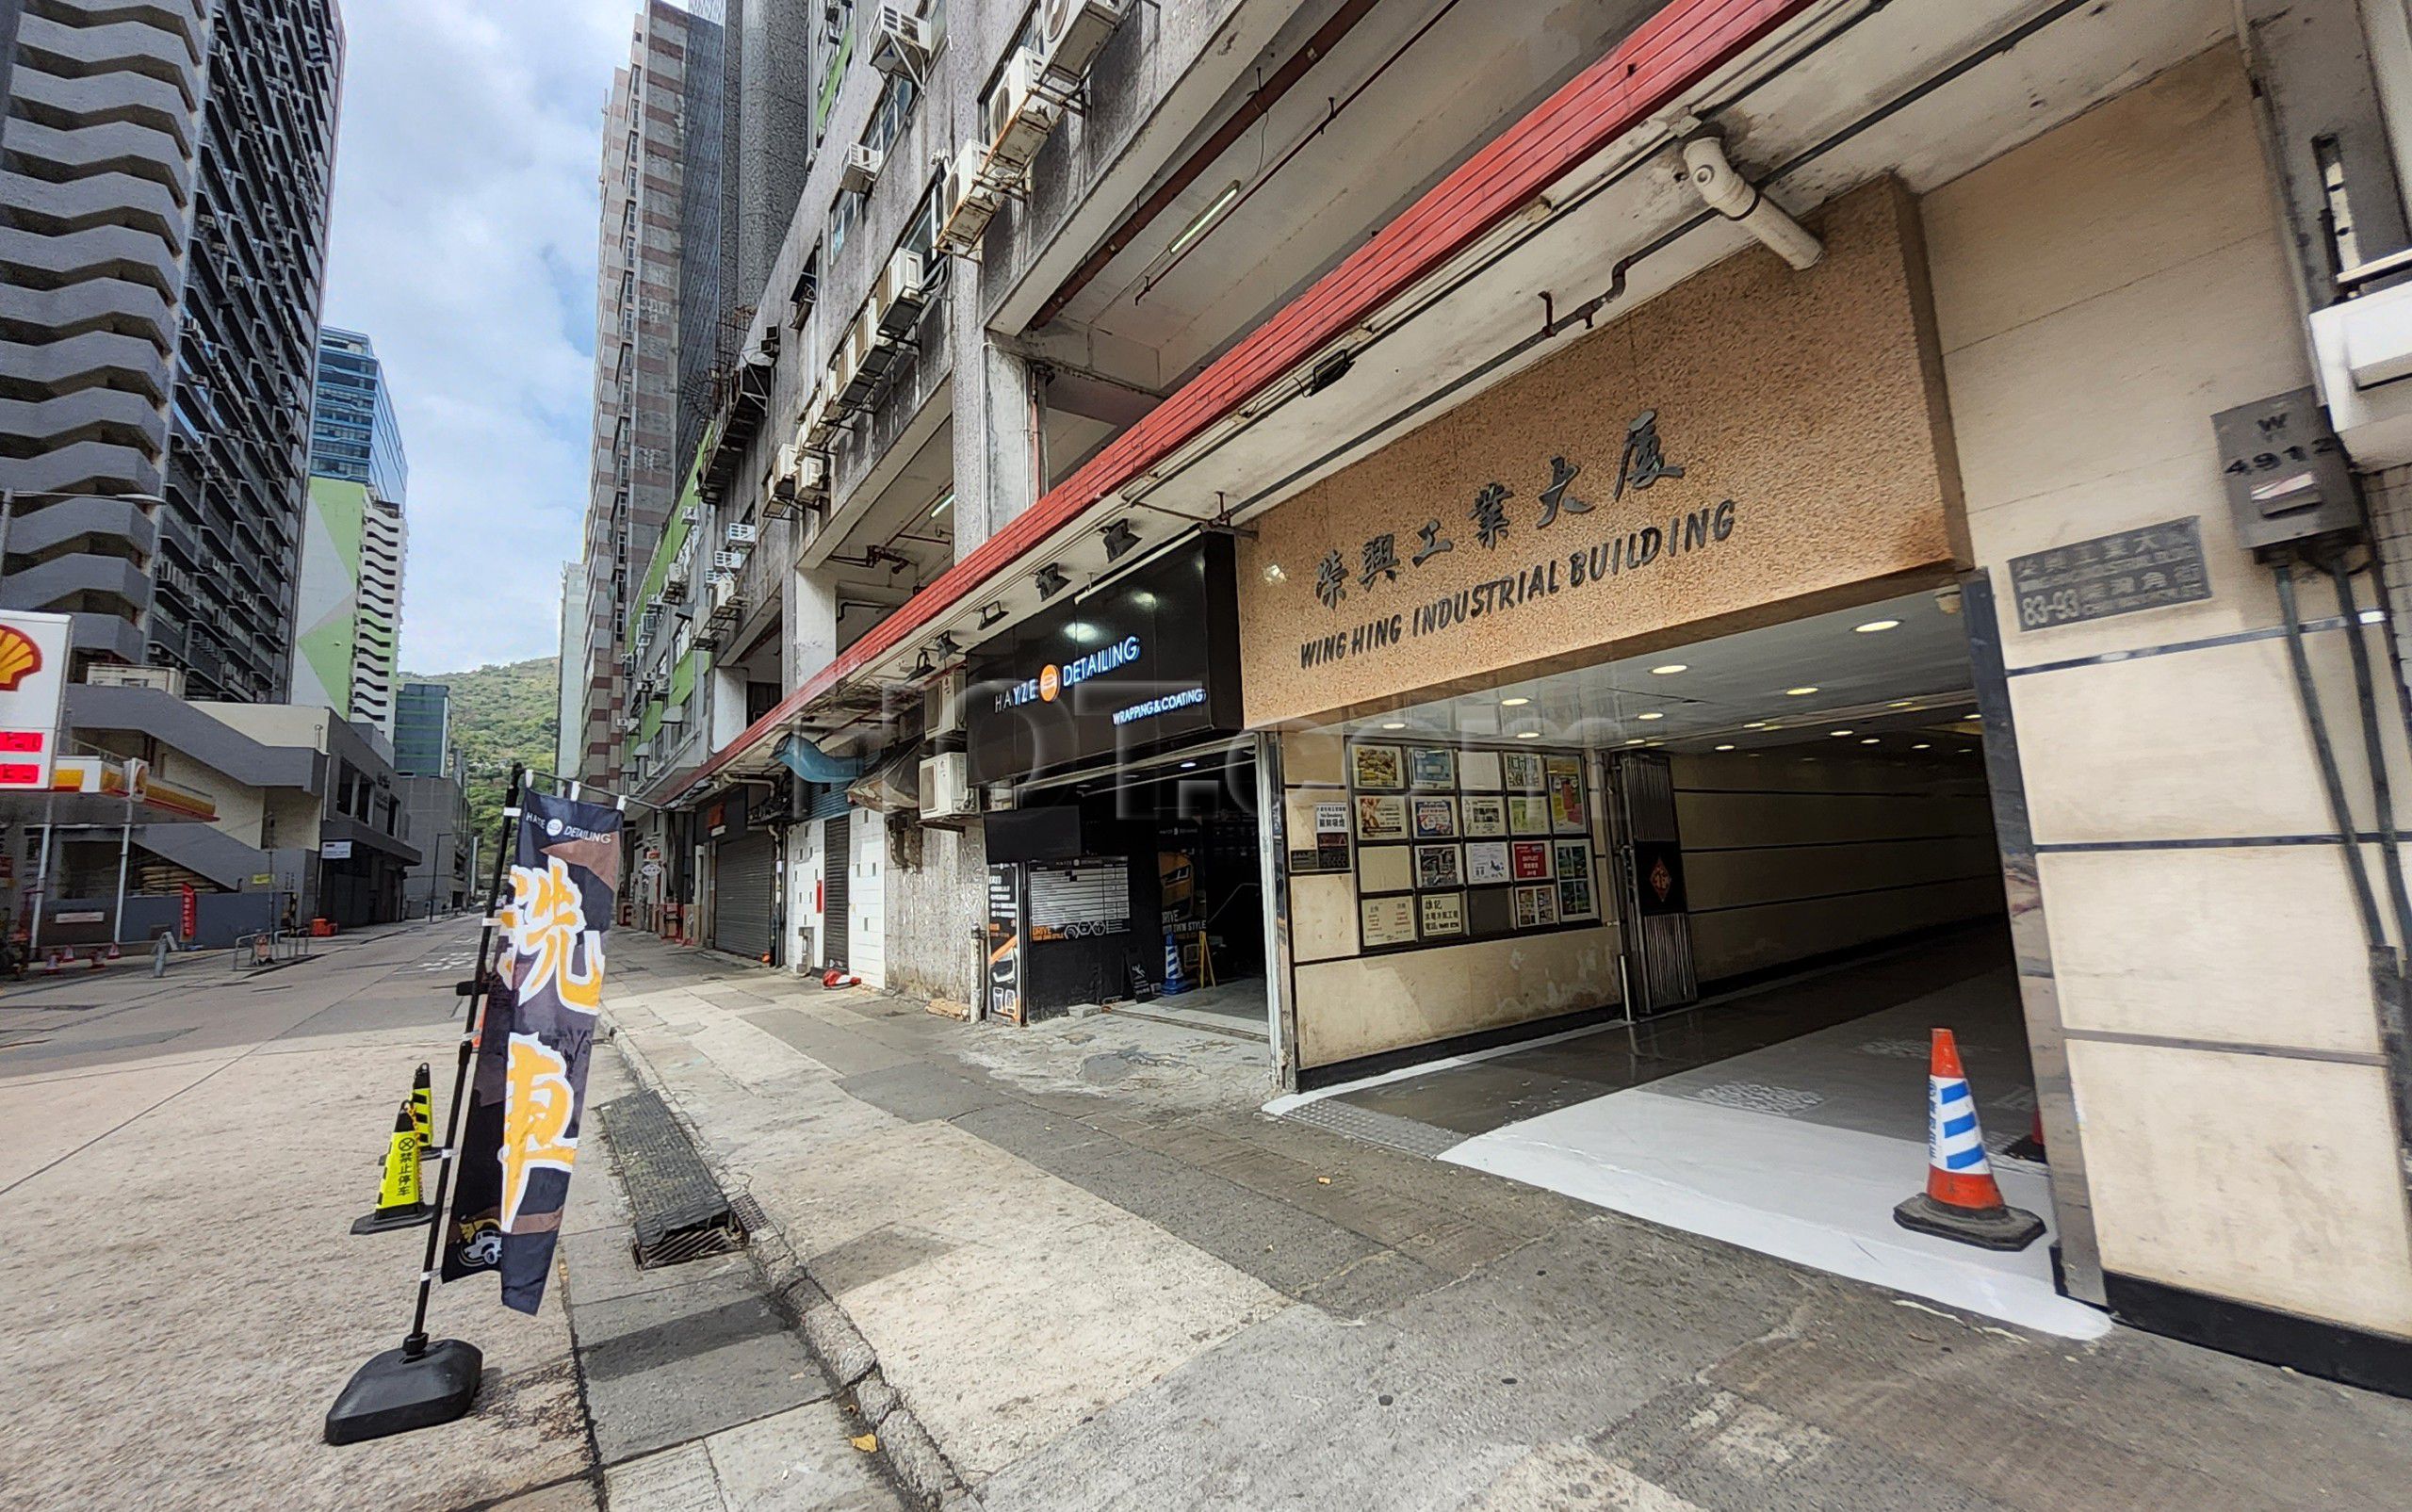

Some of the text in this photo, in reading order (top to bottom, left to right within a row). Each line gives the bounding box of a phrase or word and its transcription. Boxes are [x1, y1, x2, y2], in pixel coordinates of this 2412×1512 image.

[2257, 412, 2289, 432] W
[2225, 437, 2339, 475] 4912
[1300, 499, 1736, 670] WING HING INDUSTRIAL BUILDING
[995, 636, 1140, 713] HAYZE DETAILING
[1162, 689, 1206, 711] COATING
[563, 825, 611, 844] DETAILING
